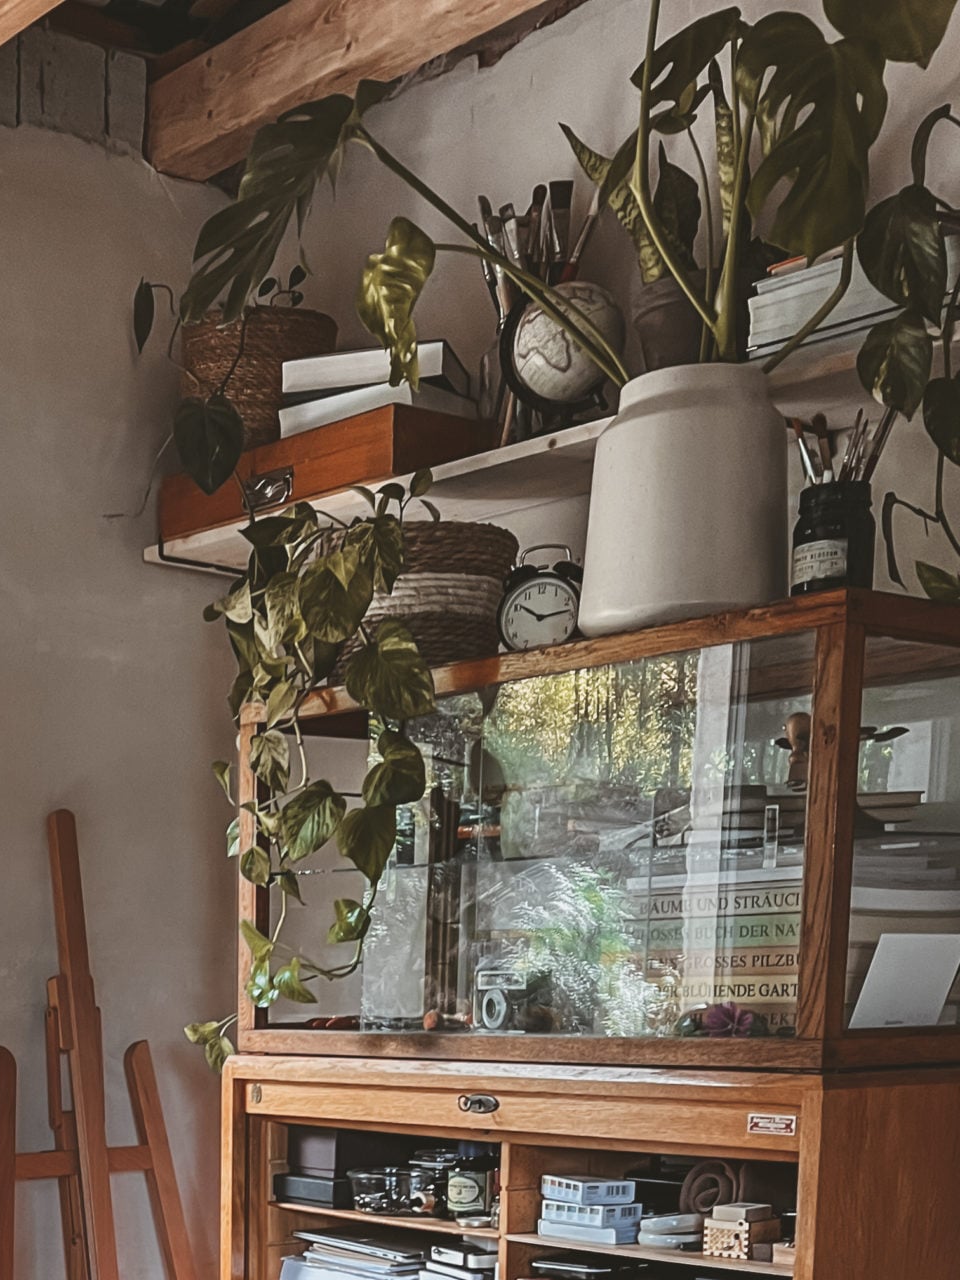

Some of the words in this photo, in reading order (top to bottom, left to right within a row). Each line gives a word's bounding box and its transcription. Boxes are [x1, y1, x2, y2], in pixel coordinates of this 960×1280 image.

[697, 896, 729, 912] UND
[696, 924, 733, 940] BUCH
[739, 924, 769, 938] DER
[687, 954, 747, 969] GROSSES
